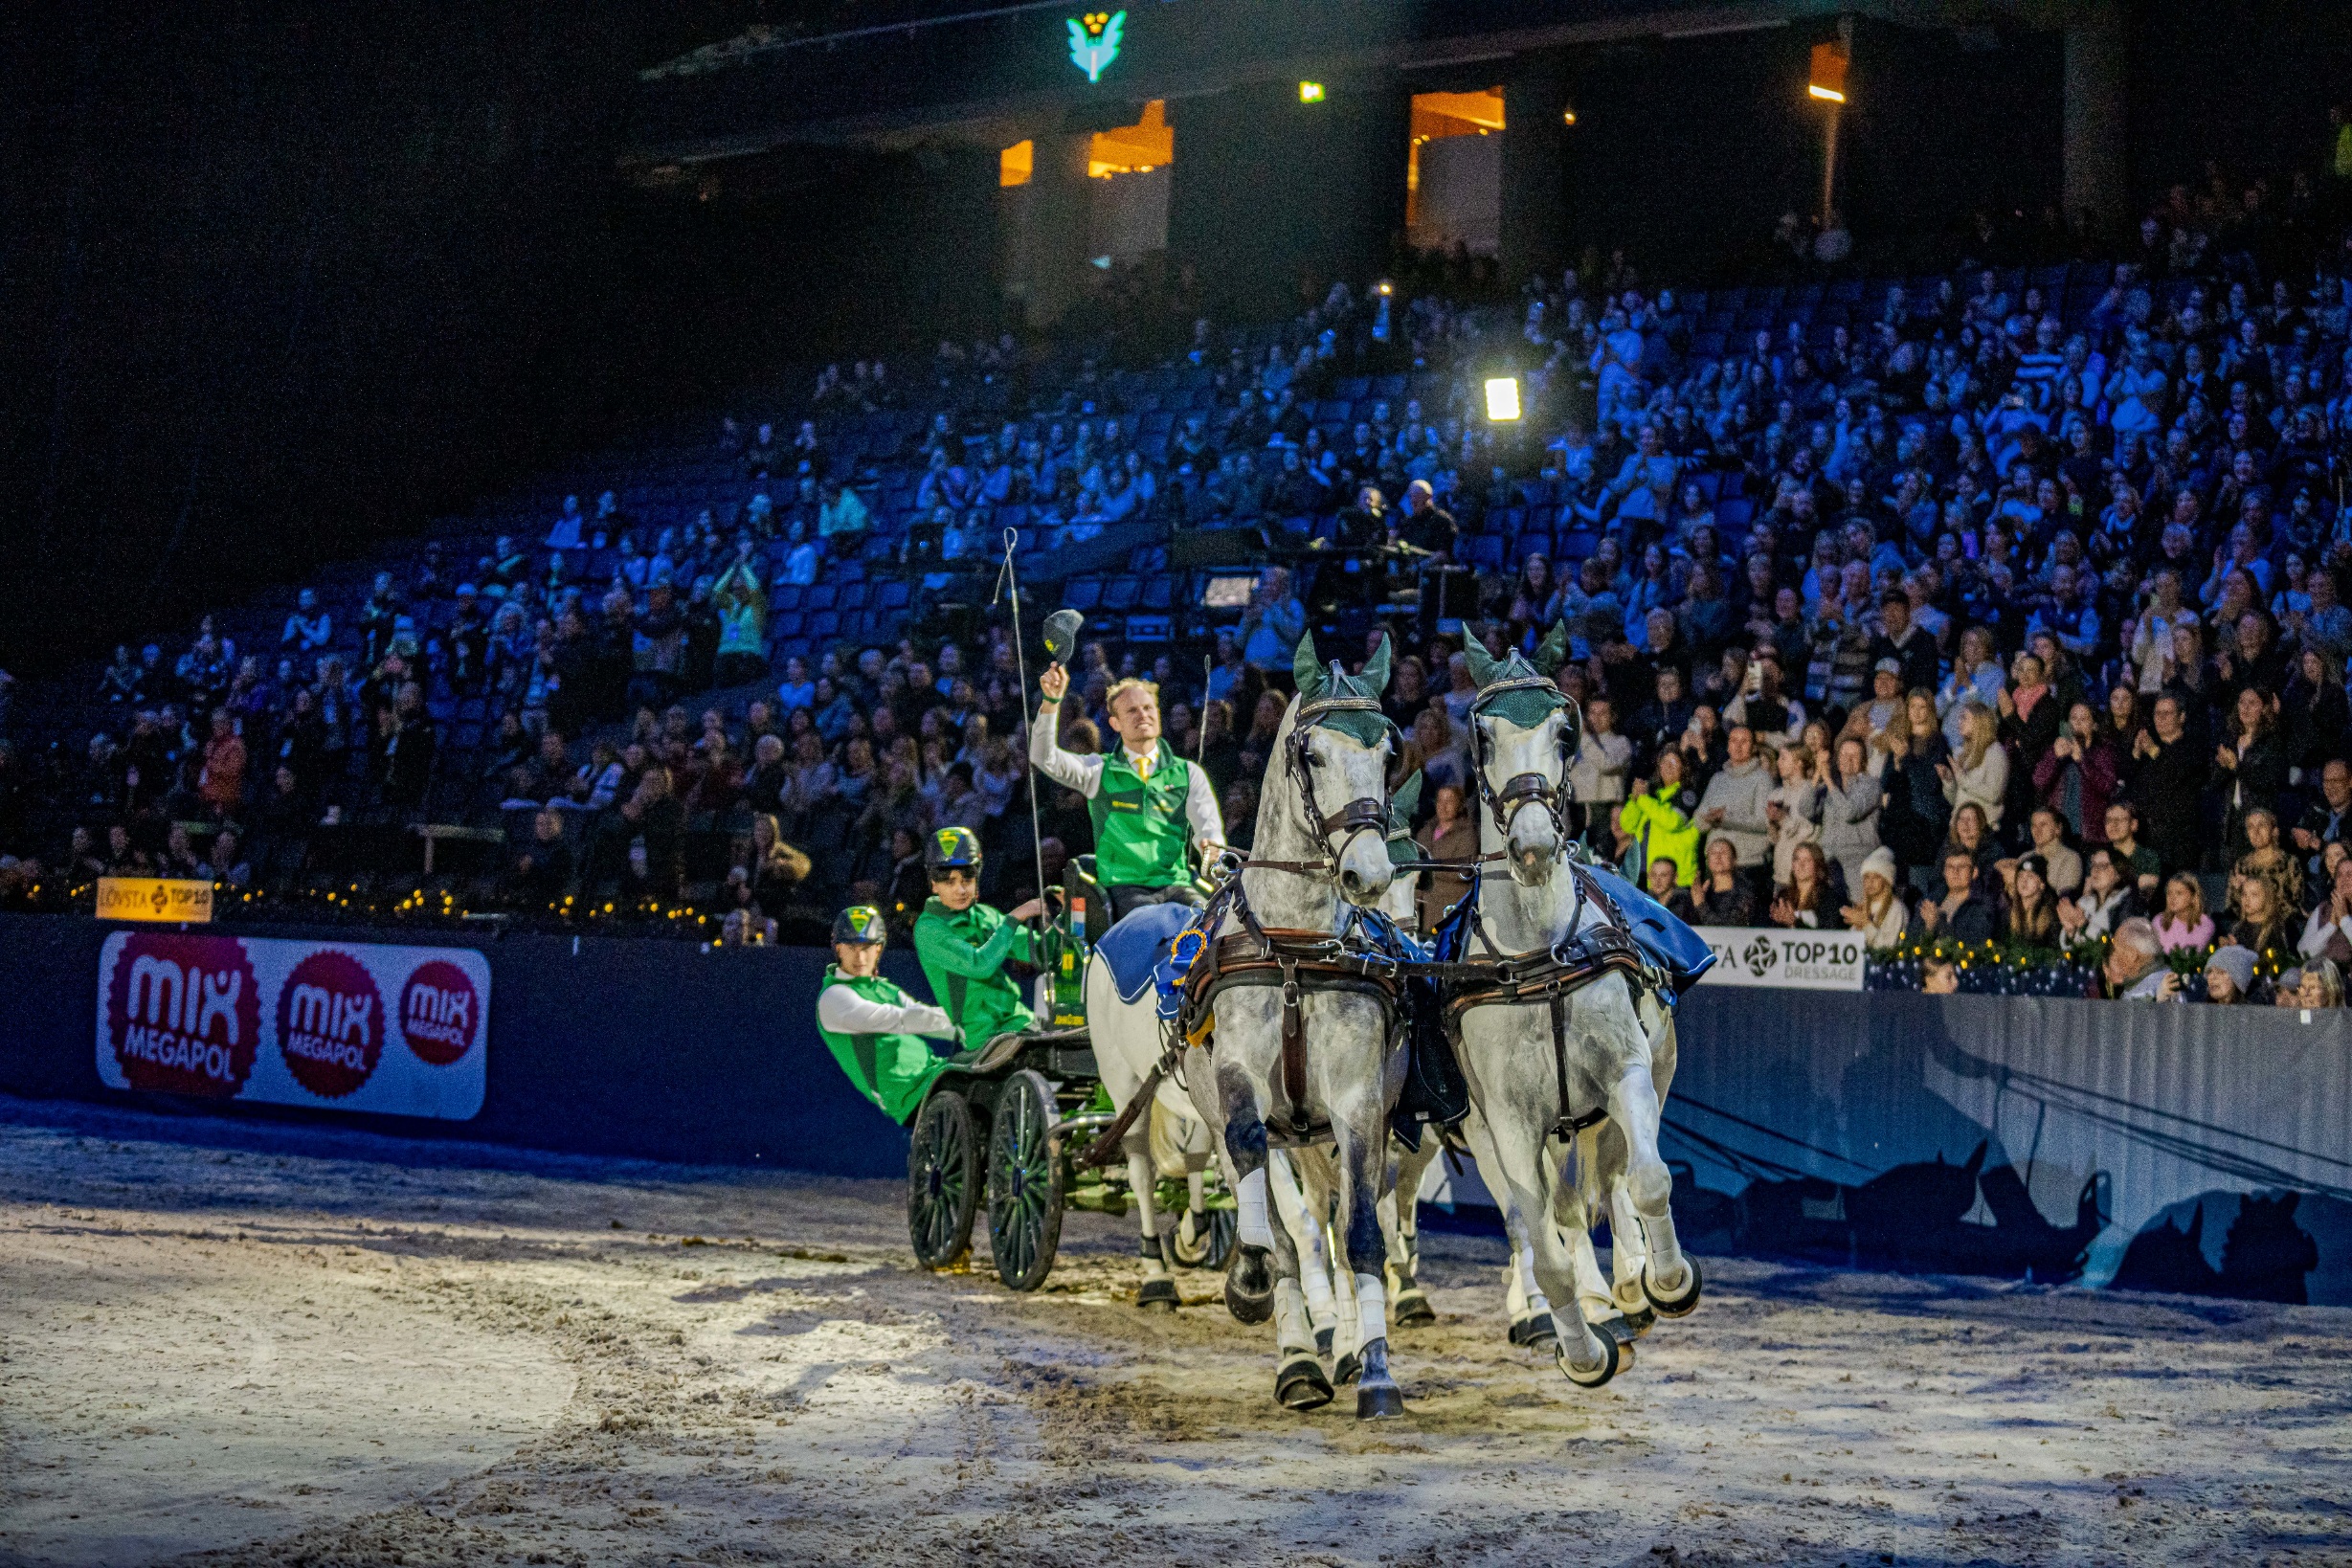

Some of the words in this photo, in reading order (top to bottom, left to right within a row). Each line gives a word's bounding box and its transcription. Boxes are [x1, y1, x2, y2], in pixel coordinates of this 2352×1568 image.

[1784, 966, 1856, 981] DRESSAGE
[406, 1019, 466, 1047] MEGAPOL
[123, 1023, 235, 1082] MEGAPOL
[287, 1031, 368, 1071] MEGAPOL
